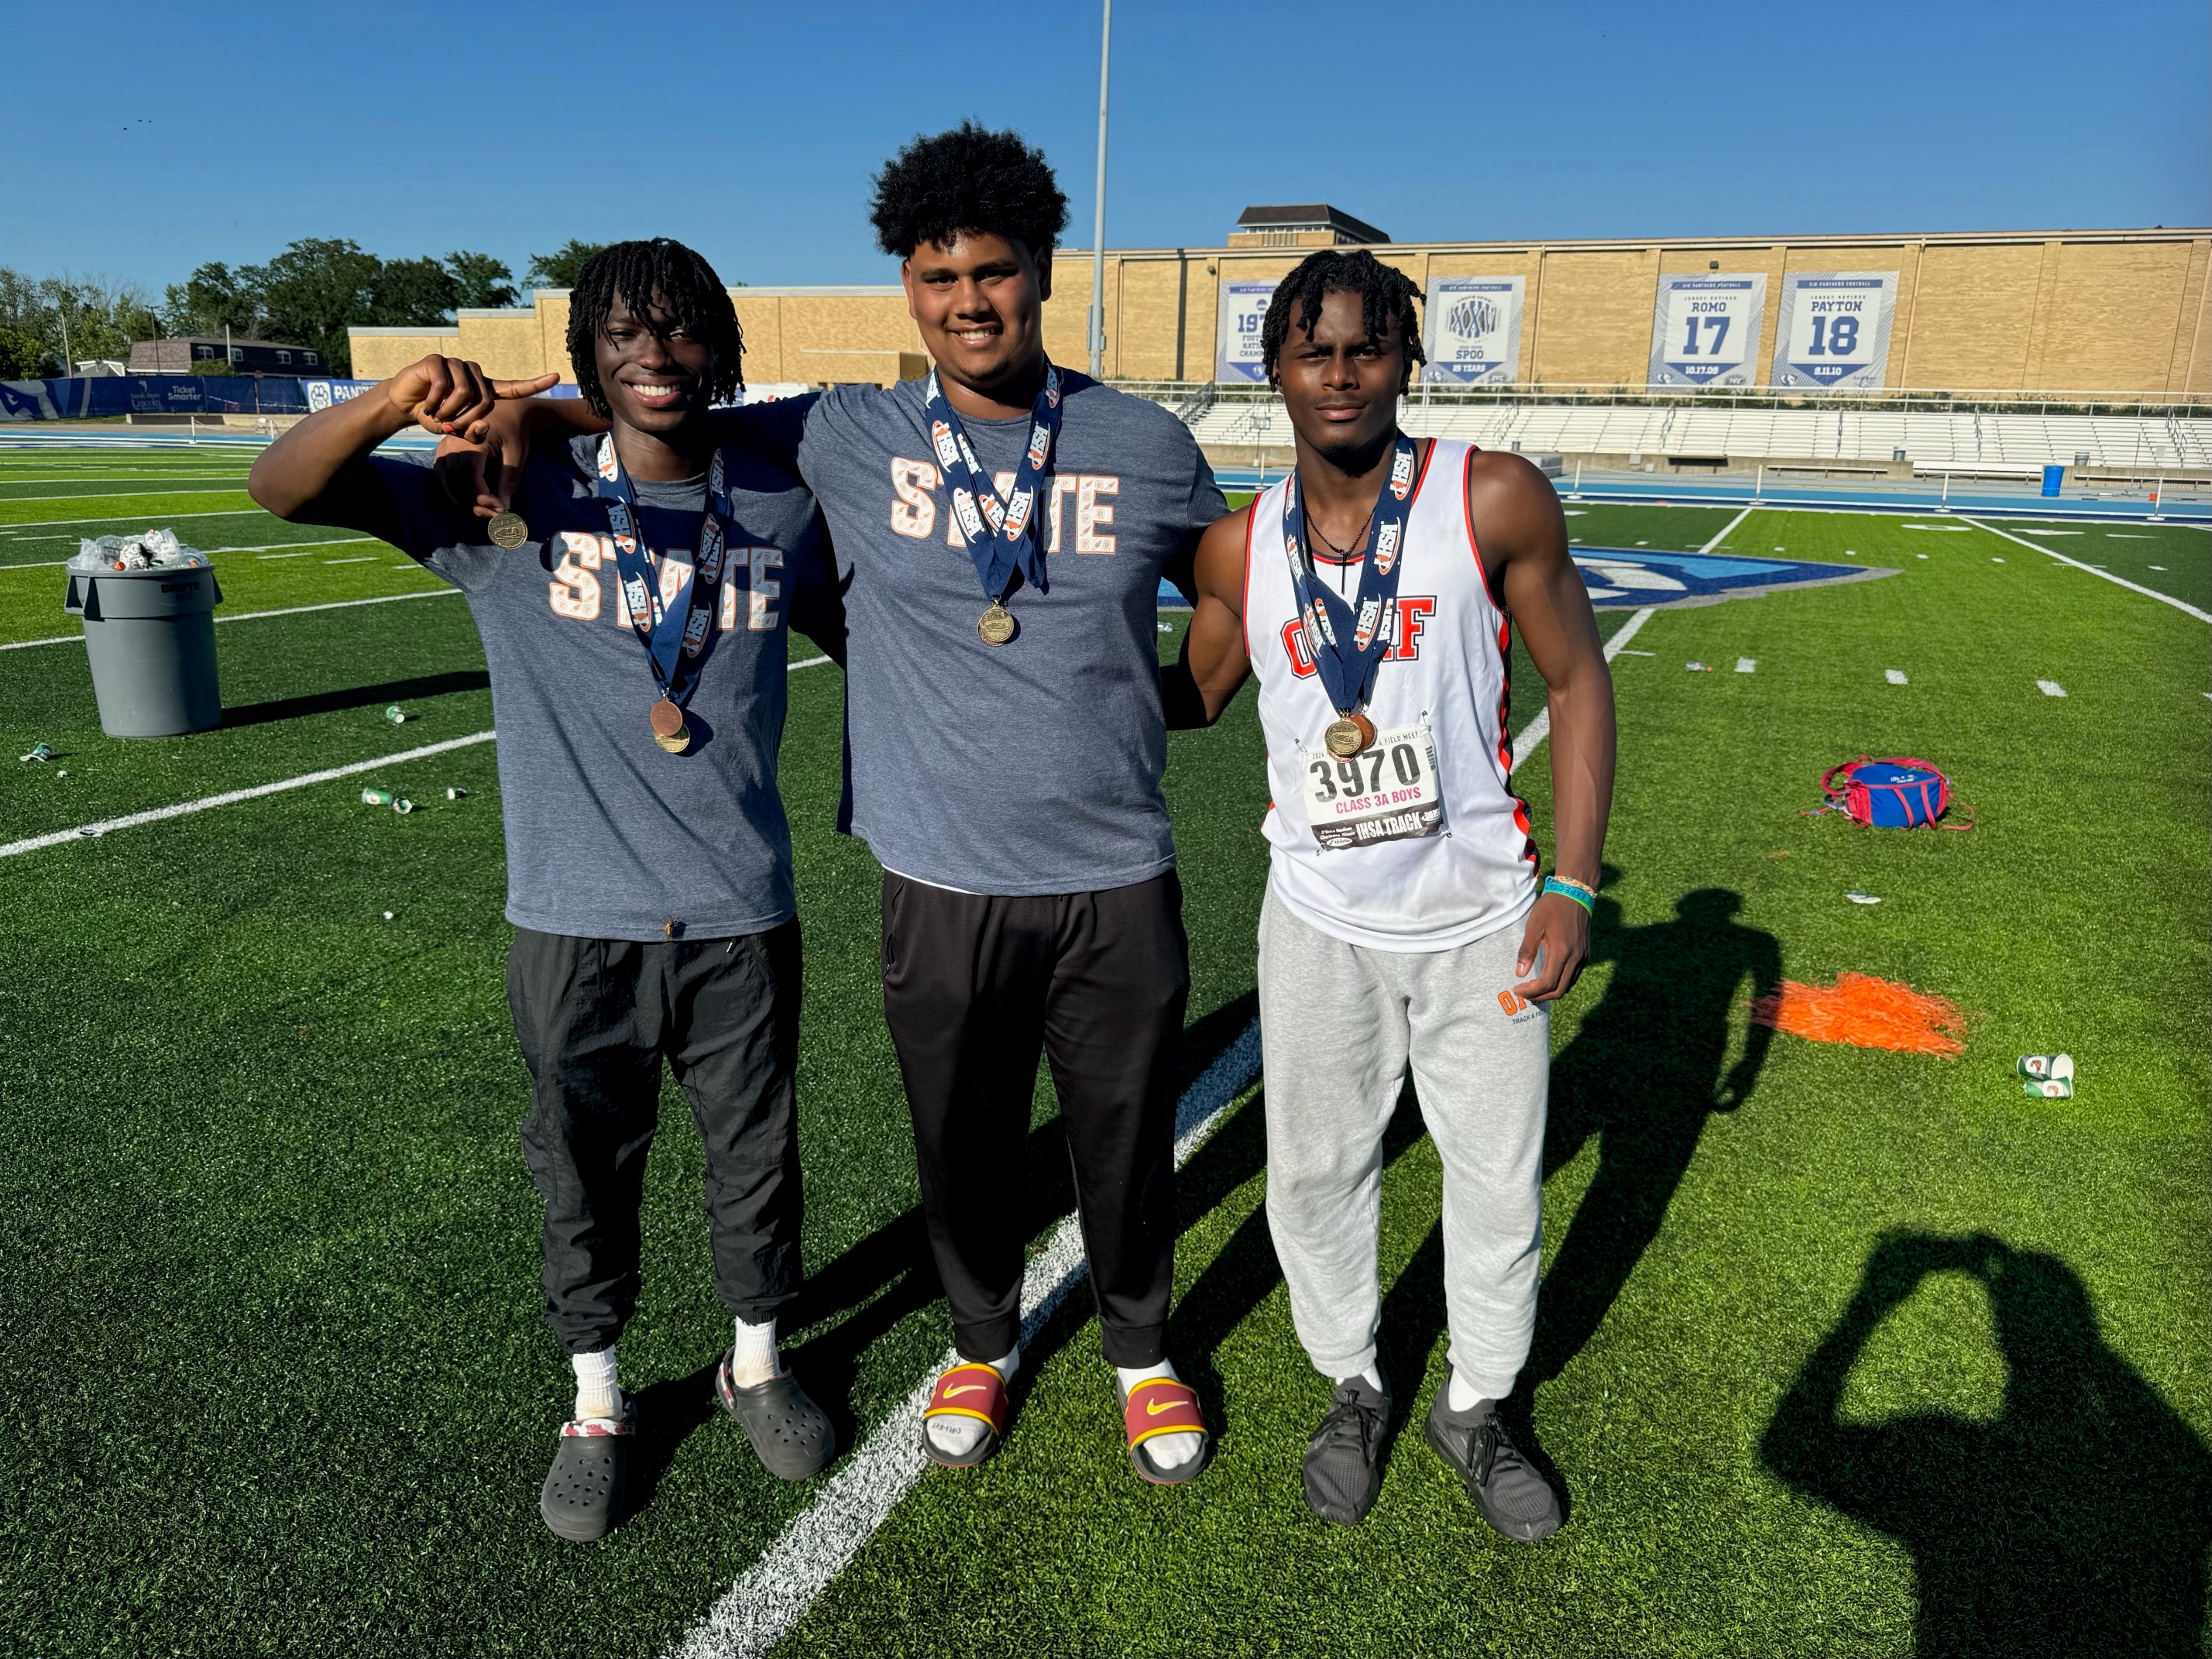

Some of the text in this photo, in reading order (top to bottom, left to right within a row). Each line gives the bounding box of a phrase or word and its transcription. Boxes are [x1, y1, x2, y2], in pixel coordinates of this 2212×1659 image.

[1692, 301, 1726, 312] ROMO
[1811, 301, 1863, 311] PAYTON
[1683, 316, 1730, 355] 17
[1808, 316, 1859, 356] 18
[1455, 350, 1484, 359] SPOO
[1685, 366, 1719, 375] 10.17.09
[171, 385, 196, 393] Ticket
[167, 392, 201, 400] Smarter
[132, 398, 162, 407] Lincoln
[1374, 524, 1398, 568] IHSA
[161, 581, 199, 593] BRUTE
[1280, 595, 1437, 680] OF
[1385, 736, 1401, 744] FIELD
[1403, 731, 1419, 740] MEET
[1310, 744, 1420, 803] 3970
[1335, 786, 1422, 815] CLASS 3A BOYS
[1355, 819, 1385, 840] IHSA
[1383, 812, 1424, 836] TRACK
[1513, 1015, 1530, 1025] TRACK
[931, 1422, 961, 1434] DRI-FIT
